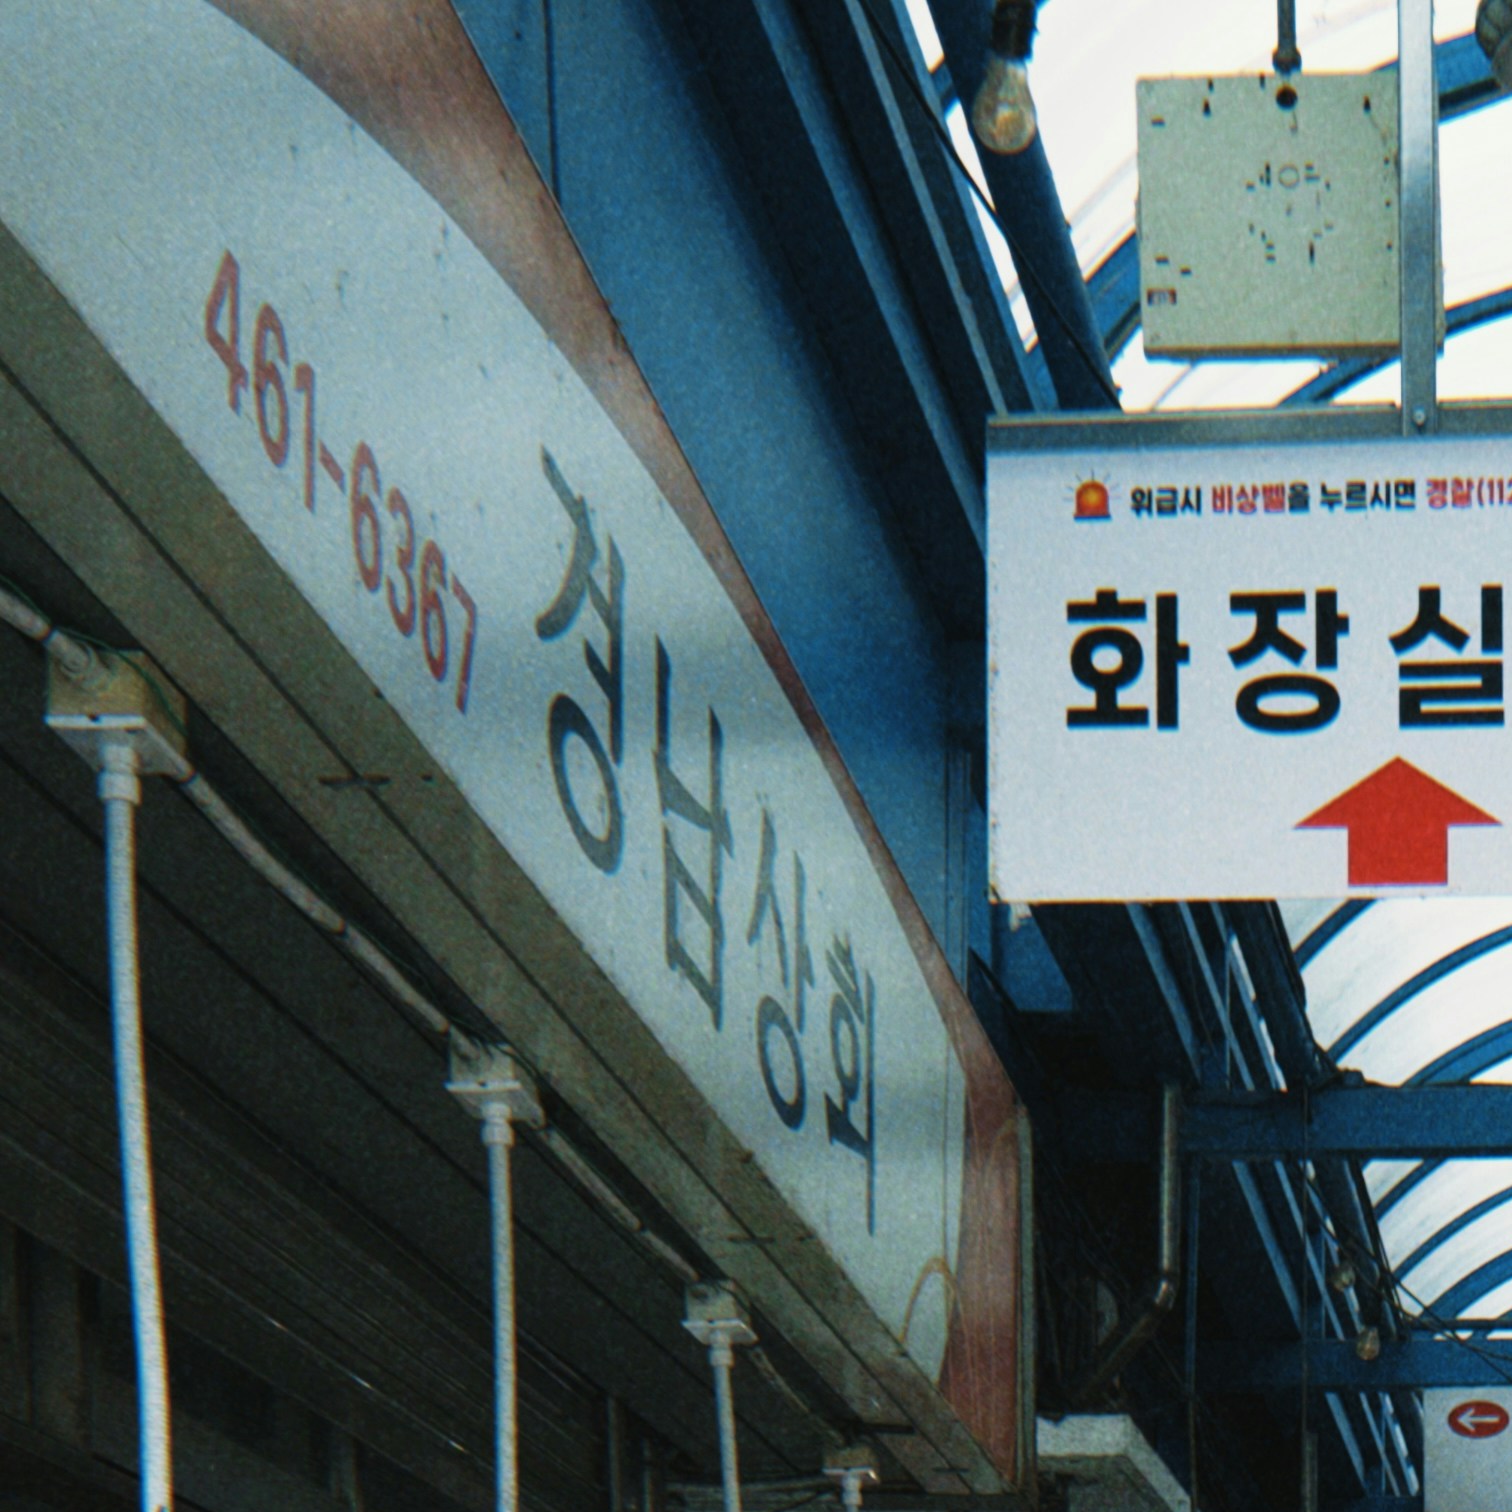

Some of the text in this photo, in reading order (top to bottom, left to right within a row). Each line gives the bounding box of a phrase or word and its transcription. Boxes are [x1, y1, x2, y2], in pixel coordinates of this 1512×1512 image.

[203, 248, 480, 715] 461-6367
[1130, 484, 1202, 518] 위급시
[1211, 481, 1310, 516] 비상벨을
[1320, 479, 1416, 514] 누르시면
[1065, 585, 1506, 735] 화장실
[536, 444, 879, 1238] 경남상회
